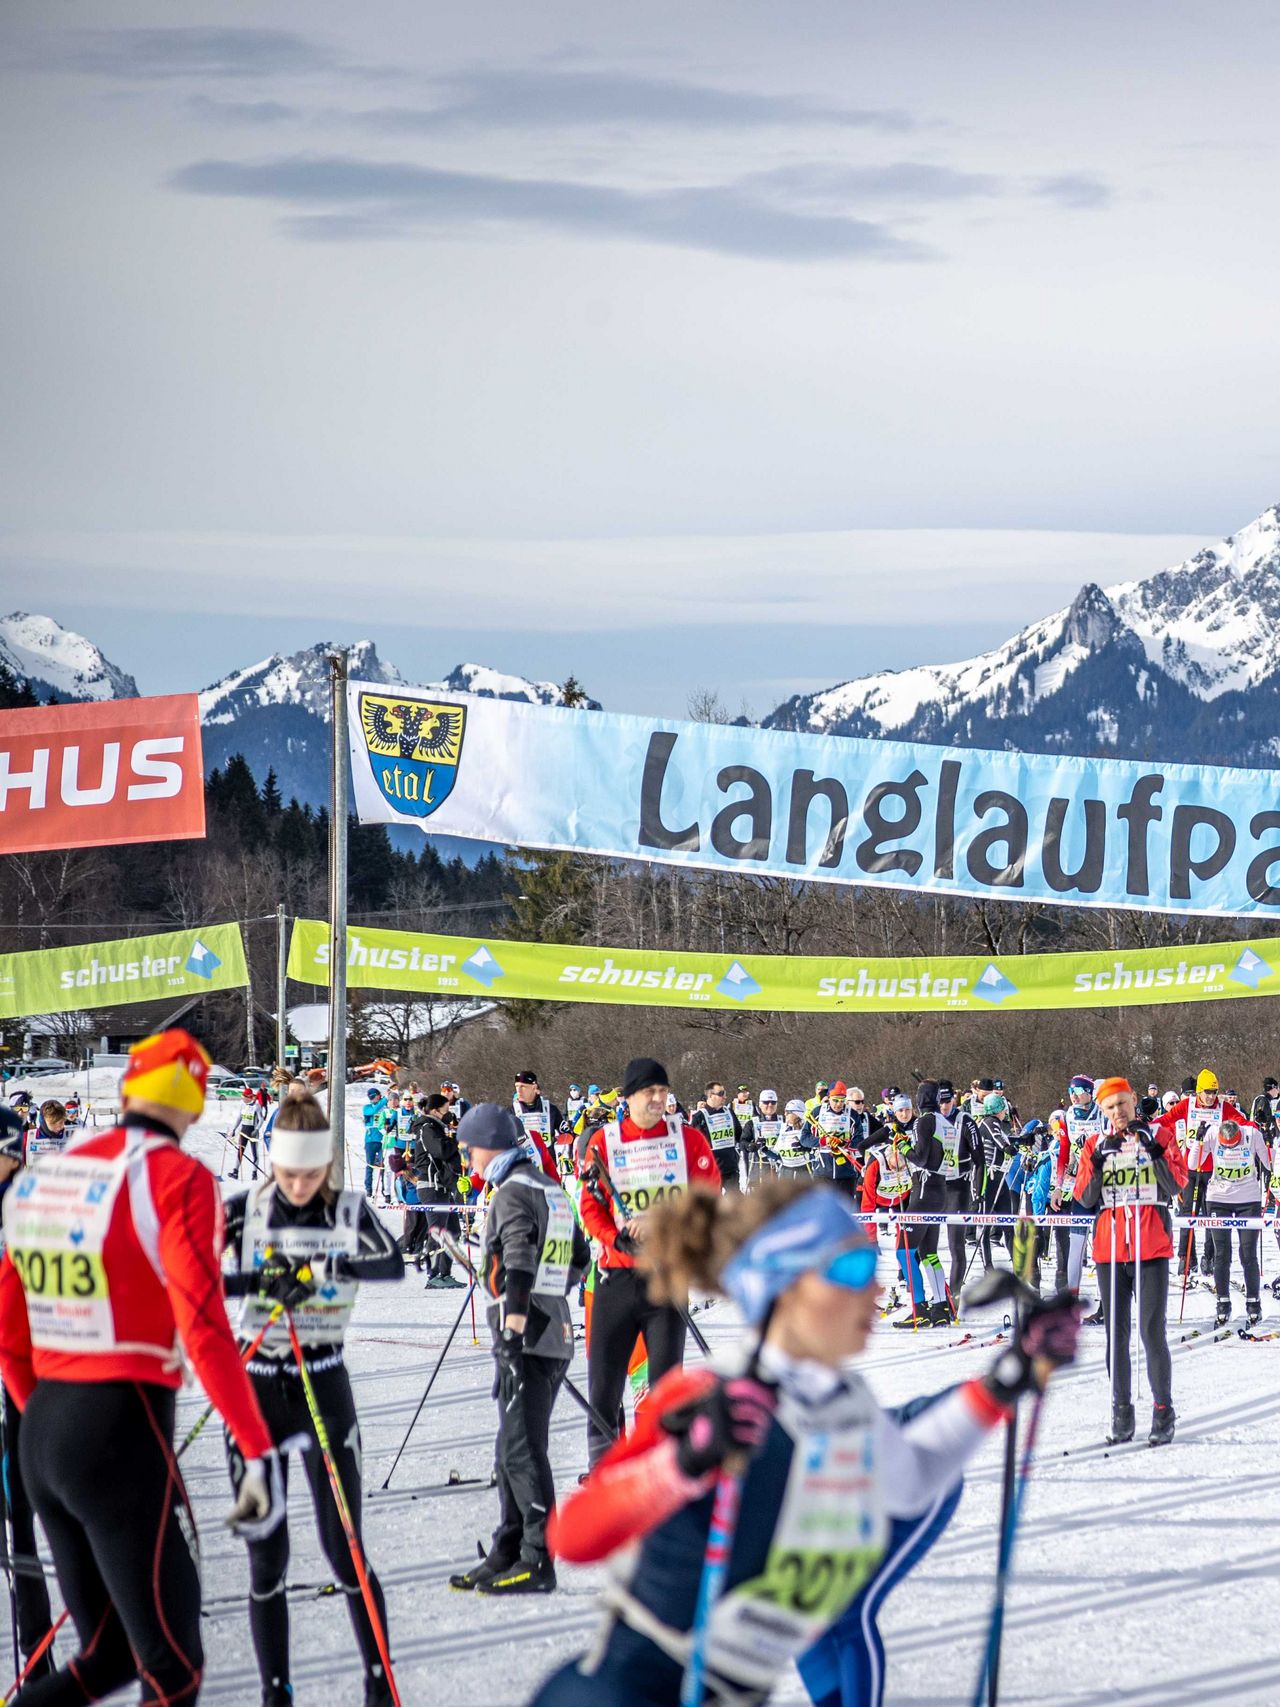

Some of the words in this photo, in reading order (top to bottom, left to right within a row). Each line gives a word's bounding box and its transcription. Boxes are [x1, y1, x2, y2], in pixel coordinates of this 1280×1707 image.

[0, 736, 184, 812] HUS
[382, 767, 435, 805] etal
[313, 936, 455, 973] shuster
[60, 954, 181, 989] schuster
[167, 976, 185, 986] 1913
[558, 959, 712, 992] schuster
[1073, 961, 1225, 994] schuster
[437, 977, 459, 987] 1913
[817, 969, 967, 999] schuster
[1203, 984, 1224, 993] 1913
[689, 993, 710, 1001] 1913
[711, 1128, 734, 1141] 2746
[1103, 1167, 1150, 1186] 2071
[1217, 1166, 1250, 1179] 2716
[1197, 1219, 1248, 1227] INTERSPORT
